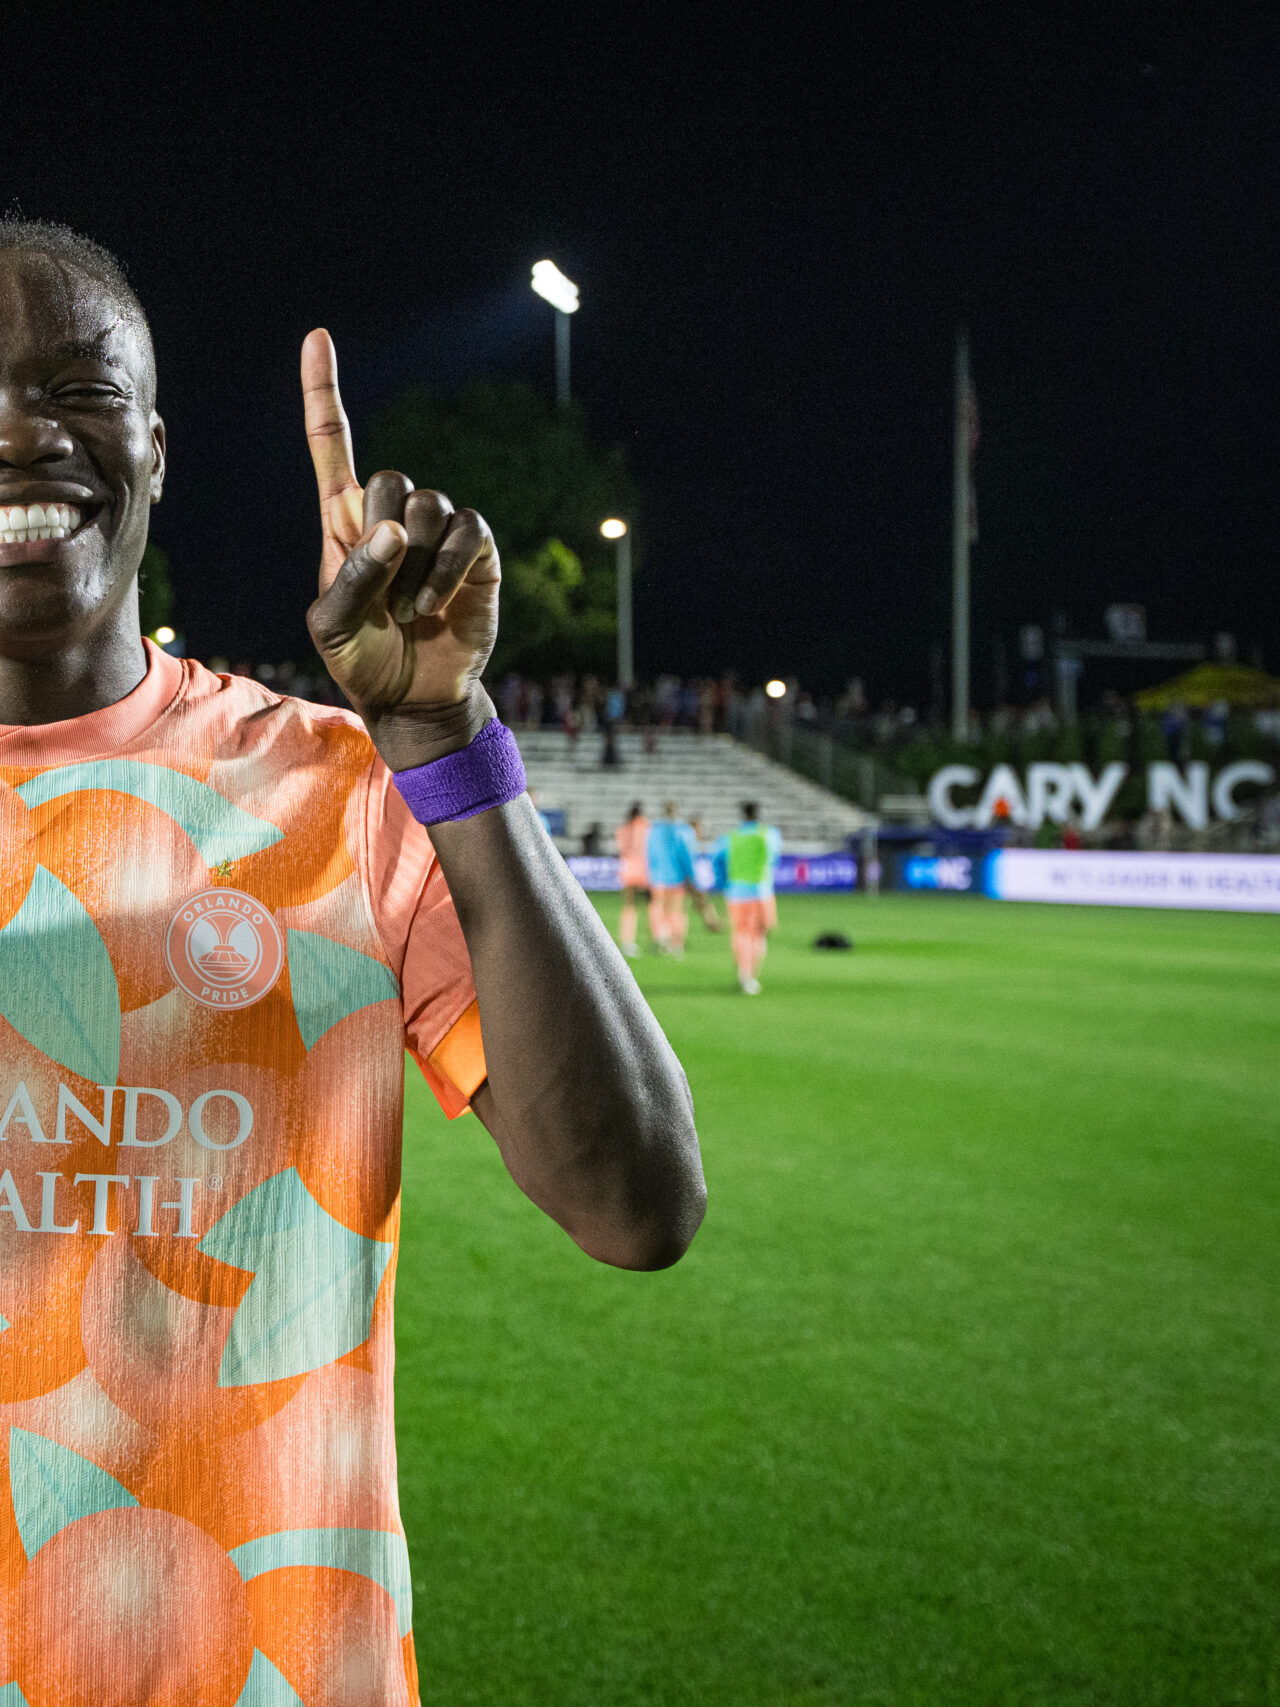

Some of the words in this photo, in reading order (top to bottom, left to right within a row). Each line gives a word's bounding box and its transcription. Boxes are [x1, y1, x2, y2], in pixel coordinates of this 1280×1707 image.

[927, 761, 1128, 831] CARY
[1148, 759, 1274, 831] NC
[183, 896, 263, 925] ORLANDO
[201, 986, 249, 1002] PRIDE
